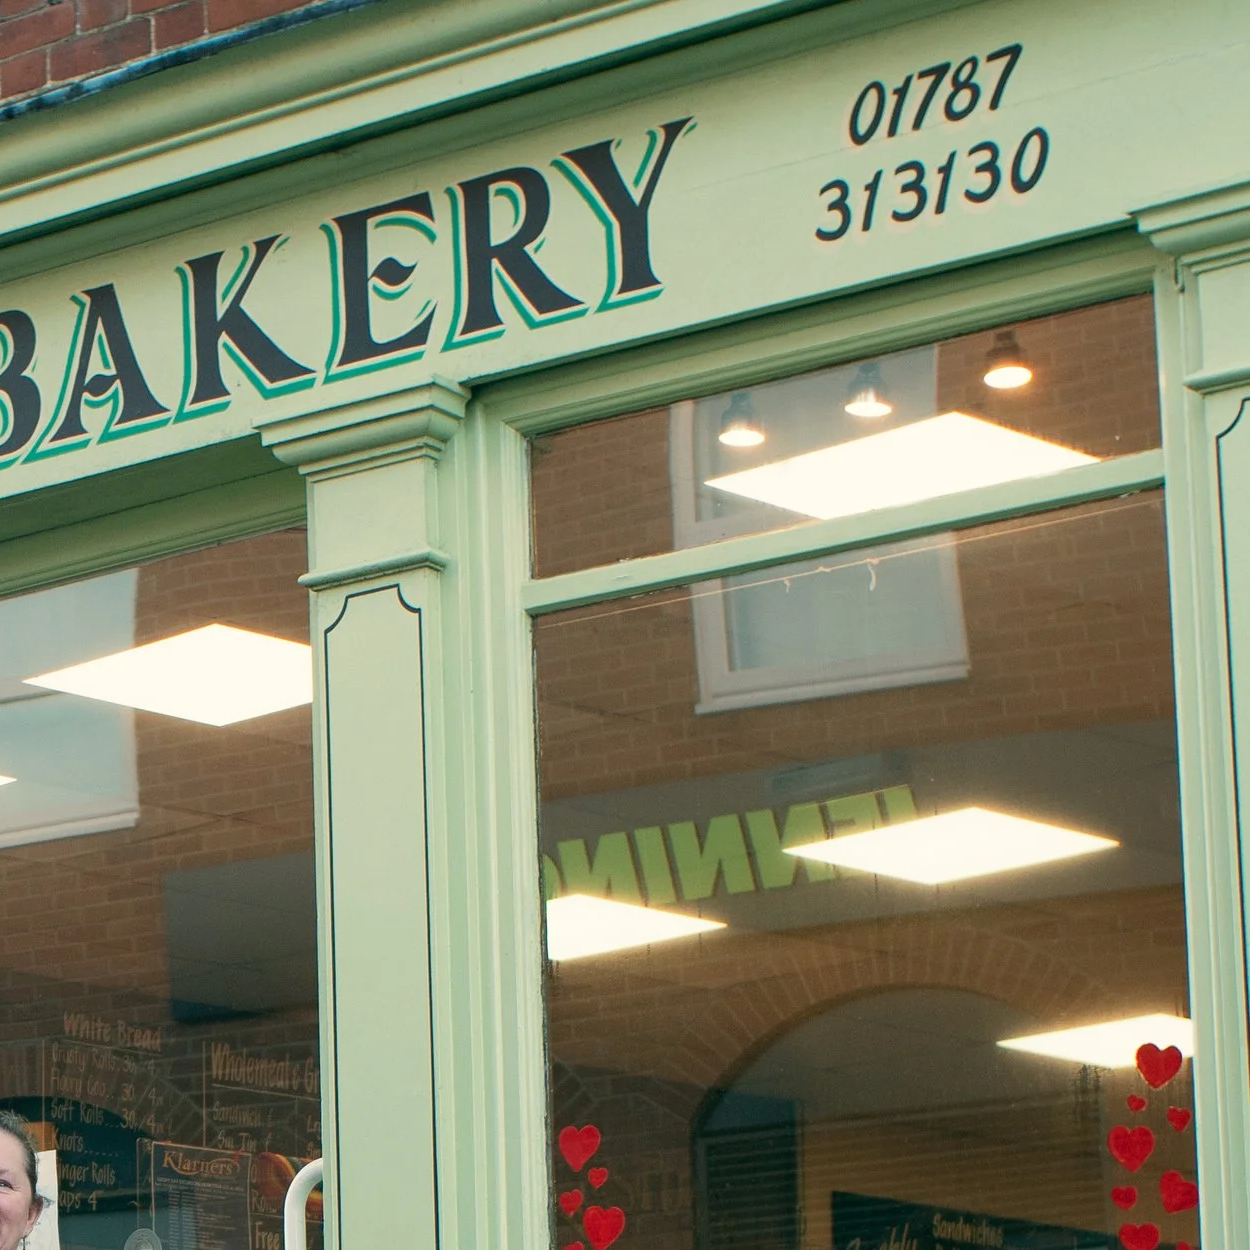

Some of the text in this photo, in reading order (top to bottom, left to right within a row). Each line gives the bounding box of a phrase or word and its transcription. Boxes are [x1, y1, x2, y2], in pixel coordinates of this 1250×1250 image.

[849, 42, 1023, 146] 01787
[815, 126, 1050, 242] 313130
[63, 1010, 162, 1052] White Bread
[210, 1041, 290, 1090] Wholemeal
[51, 1099, 76, 1123] Soft
[80, 1102, 105, 1126] Rolls
[52, 1131, 84, 1152] Knots
[57, 1161, 116, 1188] inger Rolls
[58, 1190, 81, 1212] aps
[932, 1212, 1003, 1249] Sandwiches
